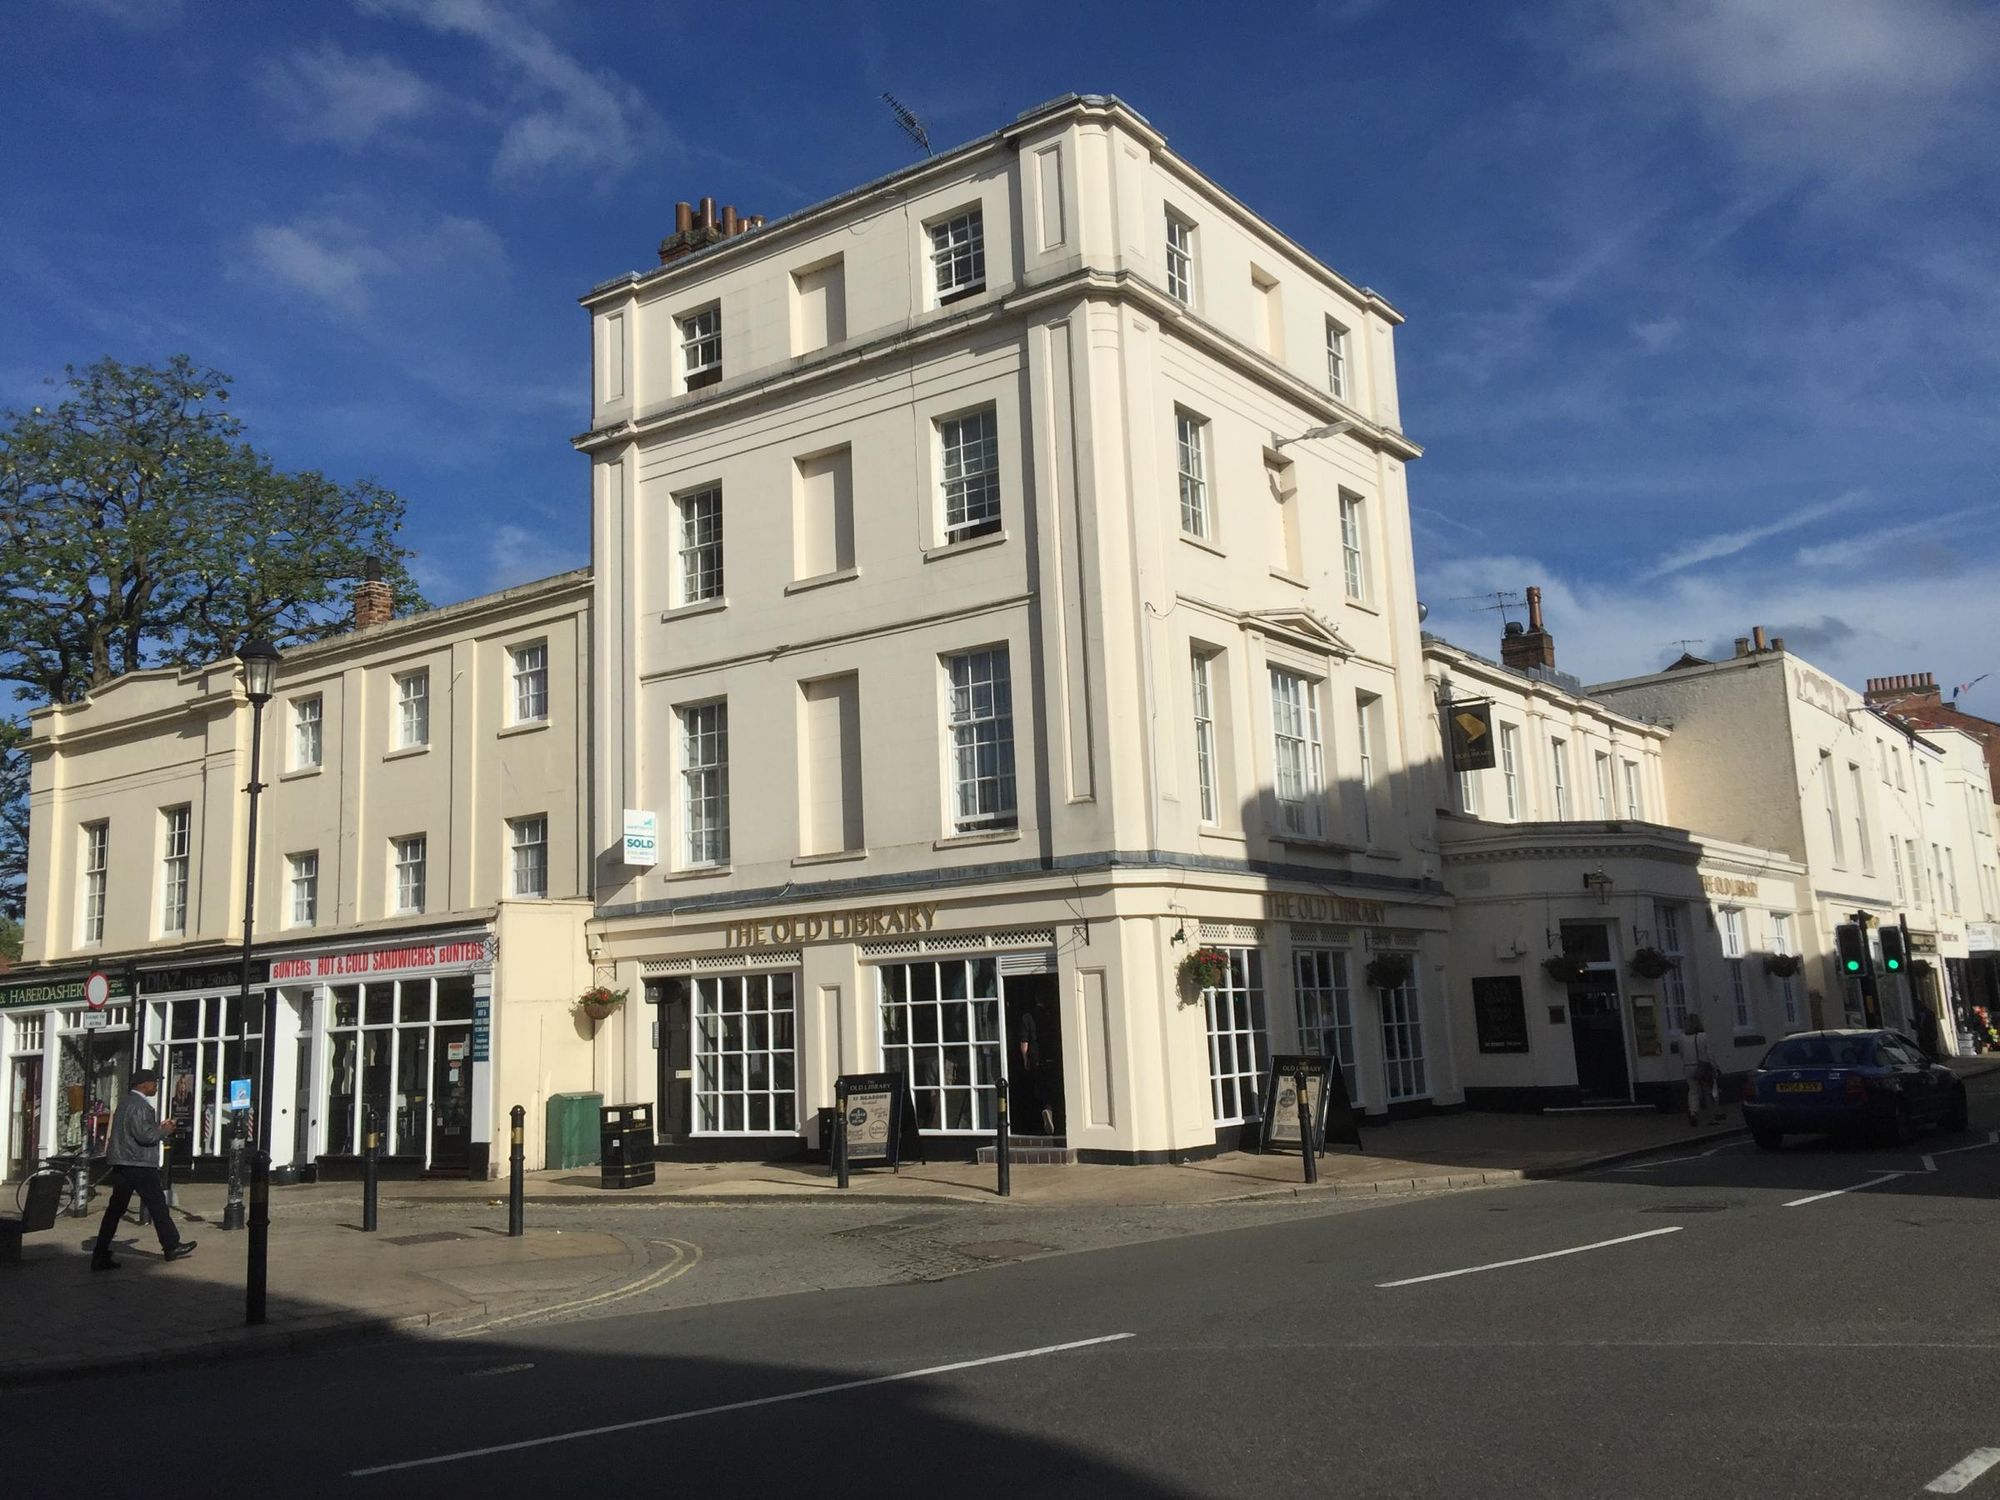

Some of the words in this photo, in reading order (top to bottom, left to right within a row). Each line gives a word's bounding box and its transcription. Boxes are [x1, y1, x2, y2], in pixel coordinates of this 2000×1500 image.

[627, 839, 654, 849] SOLD
[1265, 894, 1296, 919] THE
[1298, 896, 1327, 921] OLD
[1330, 898, 1385, 924] LIBRARY
[726, 921, 766, 949] THE
[771, 914, 823, 944] OLD
[828, 904, 939, 939] LIBRARY
[273, 959, 311, 978] BUNTERS
[318, 955, 335, 976] HOT
[337, 957, 343, 974] &
[346, 952, 368, 973] COLD
[373, 944, 435, 971] SANDWICHES
[439, 942, 484, 963] BUNTERS
[145, 971, 180, 992] DIAZ
